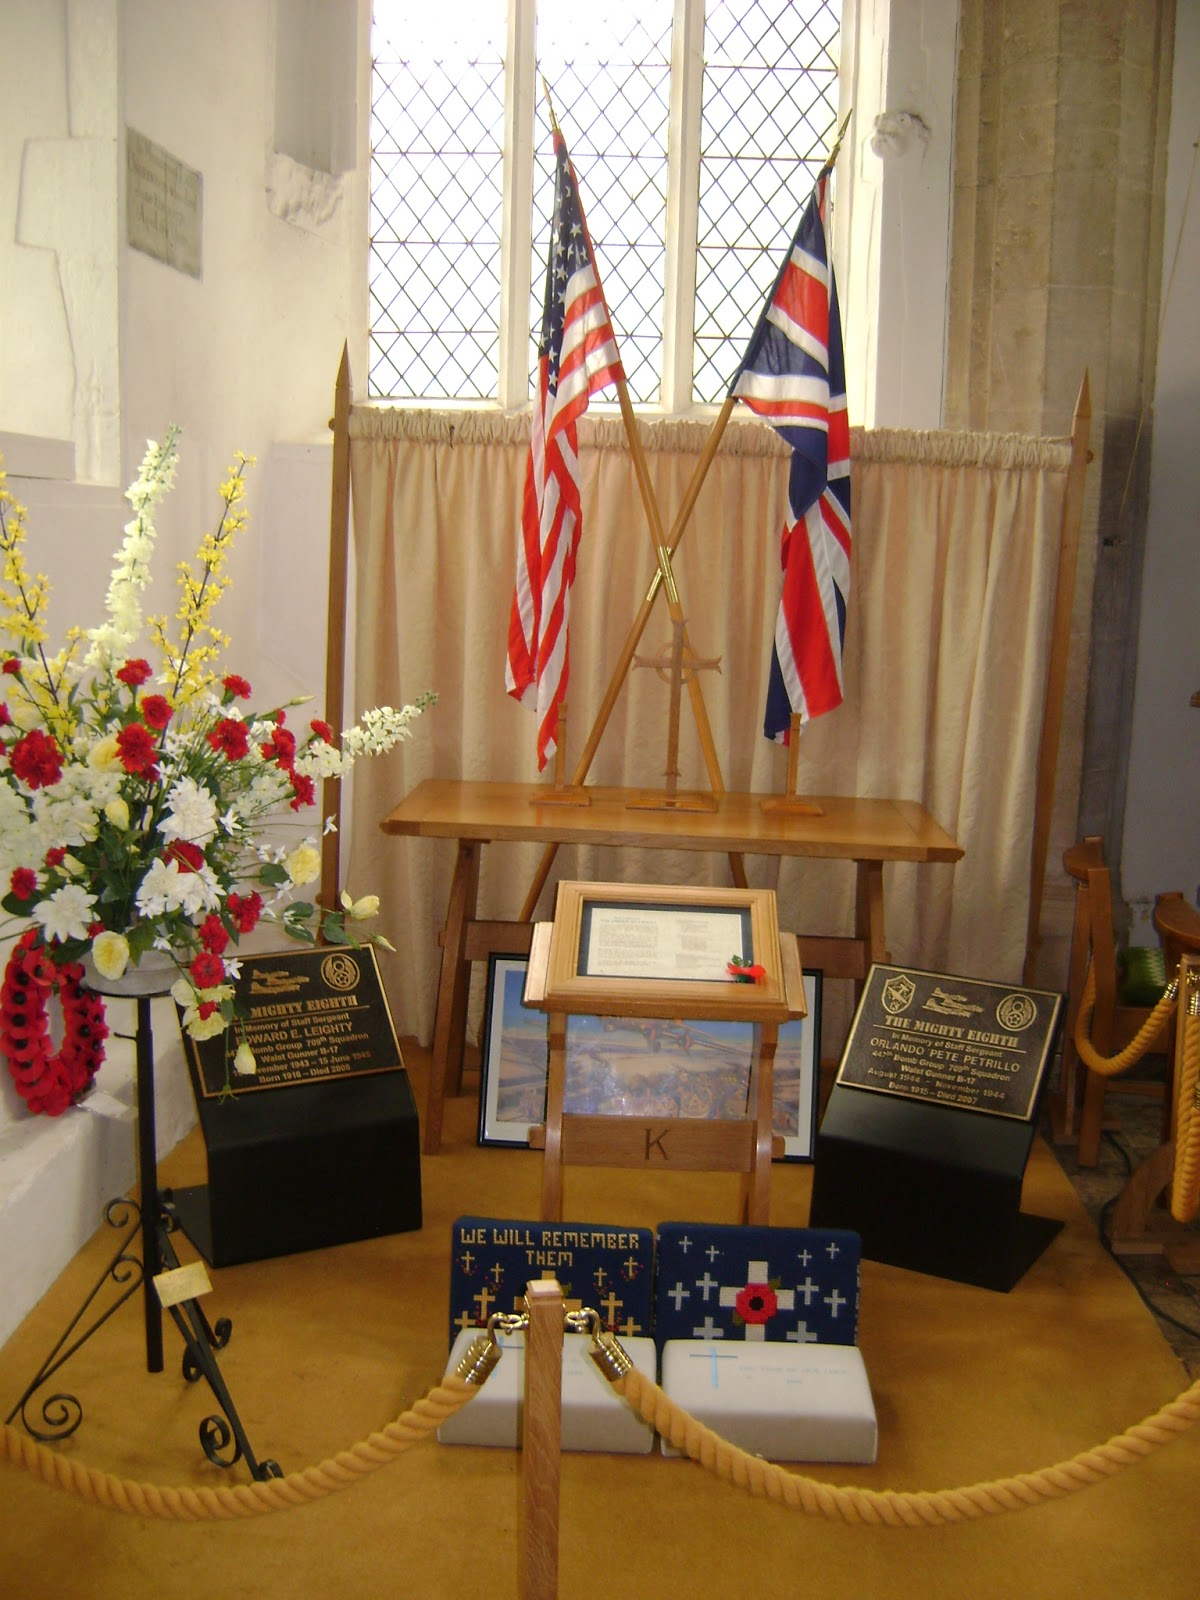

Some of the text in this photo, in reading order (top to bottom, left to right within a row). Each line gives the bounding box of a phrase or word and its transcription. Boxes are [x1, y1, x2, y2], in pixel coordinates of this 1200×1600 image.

[250, 1002, 302, 1018] MIGHTY
[306, 995, 358, 1012] EIGHTH
[245, 1022, 278, 1032] Memory
[291, 1017, 311, 1026] Staff
[312, 1012, 350, 1024] Sergeant
[291, 1029, 302, 1039] E.
[304, 1022, 352, 1037] LEIGHTY
[885, 1015, 1019, 1048] THE MIGHTY EIGHTH
[251, 1045, 274, 1054] omb
[276, 1042, 302, 1052] Group
[328, 1033, 368, 1045] Squadron
[261, 1046, 338, 1062] Waist Gunner B-17
[902, 1034, 933, 1047] Memory
[944, 1041, 966, 1051] Staff
[966, 1046, 1002, 1058] Sergeant
[256, 1064, 288, 1074] vember
[290, 1059, 310, 1069] 1943
[330, 1055, 350, 1064] June
[870, 1038, 924, 1055] ORLANDO
[964, 1055, 1020, 1072] PETRILLO
[258, 1074, 280, 1084] Born
[310, 1067, 330, 1076] Died
[894, 1054, 918, 1064] Bomb
[919, 1059, 944, 1070] Group
[970, 1068, 1010, 1081] Squadron
[901, 1064, 976, 1084] Waist Gunner B-17
[868, 1068, 898, 1078] August
[900, 1074, 920, 1082] 1944
[936, 1081, 980, 1094] November
[984, 1090, 1005, 1099] 1944
[888, 1082, 908, 1091] Born
[936, 1090, 956, 1100] Died
[644, 1128, 670, 1160] K
[460, 1228, 640, 1249] WE WILL REMEMBER
[526, 1250, 574, 1267] THEM
